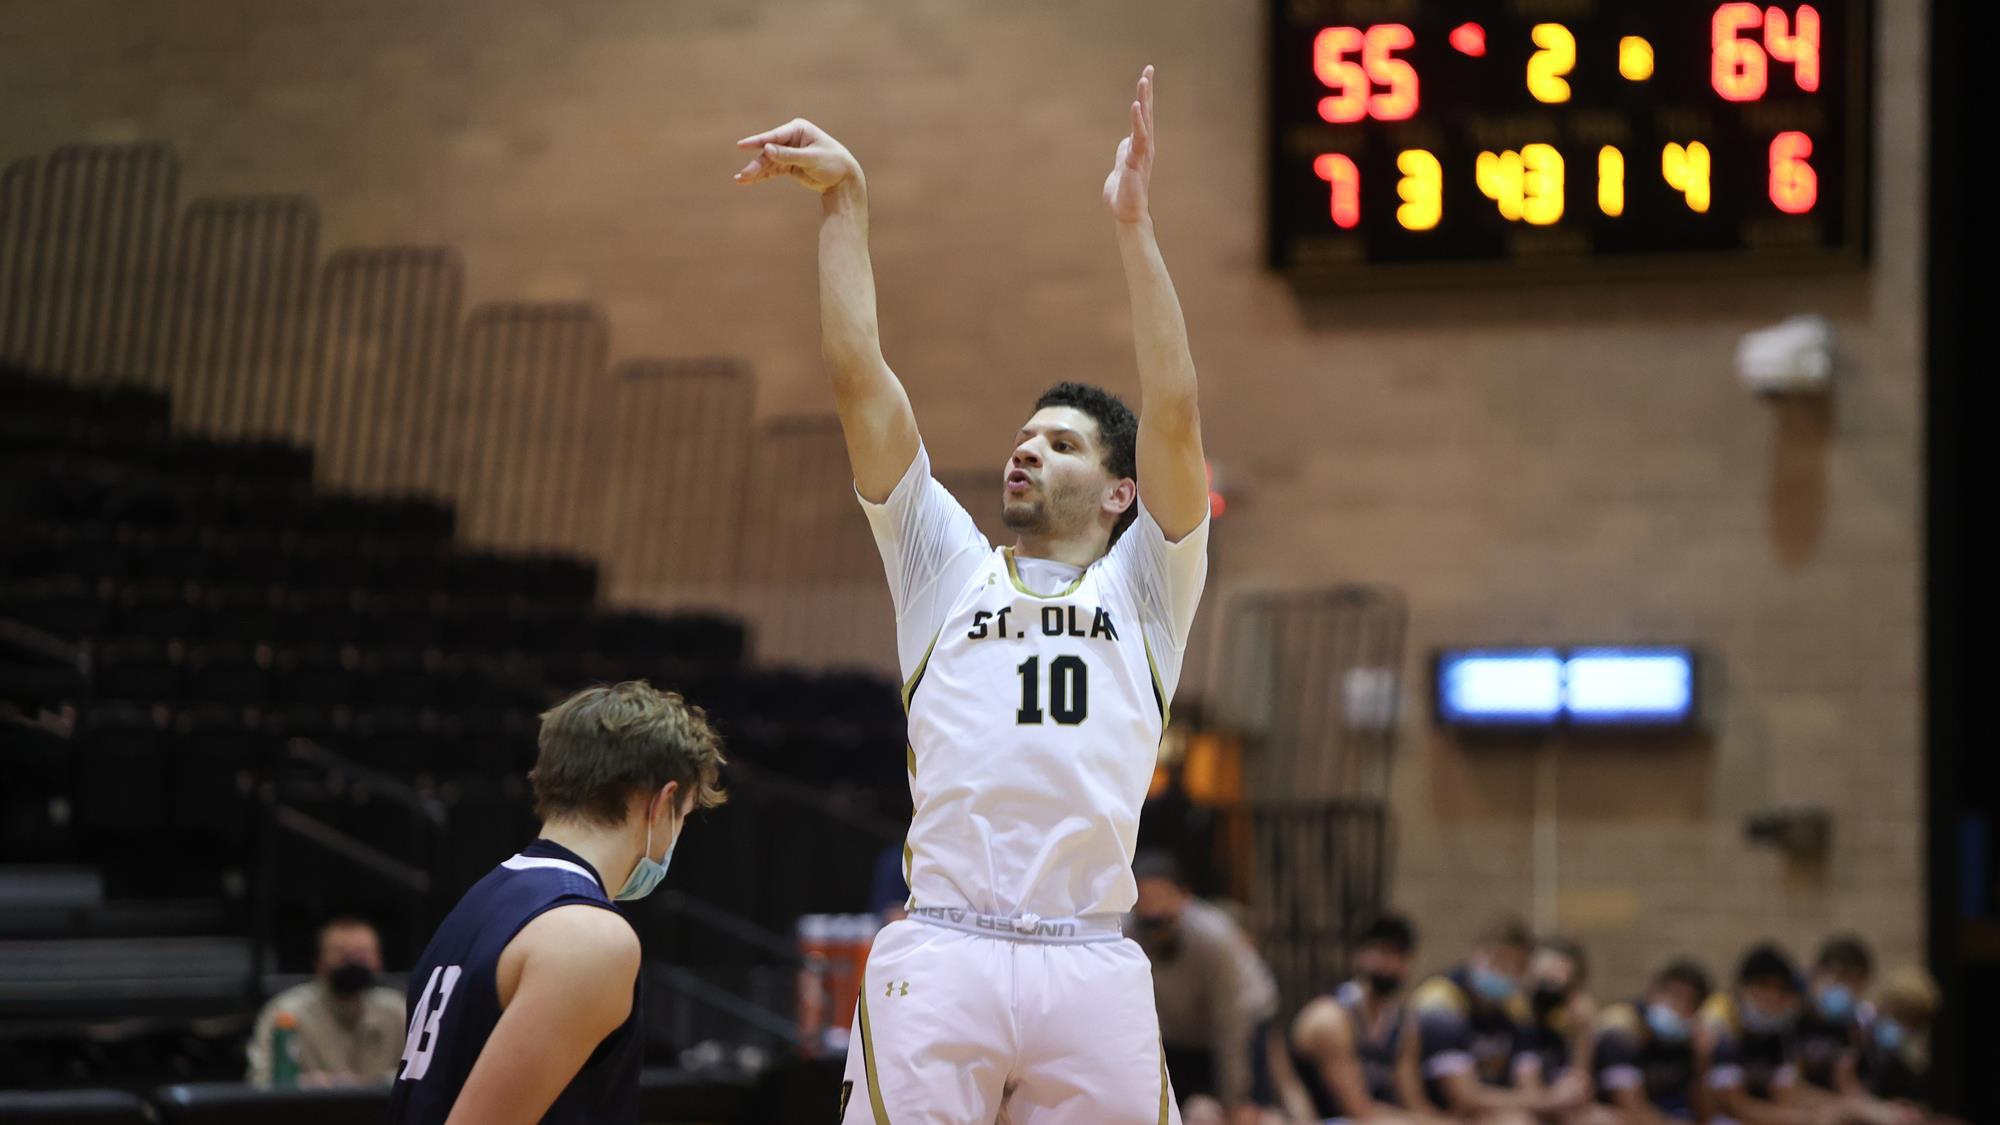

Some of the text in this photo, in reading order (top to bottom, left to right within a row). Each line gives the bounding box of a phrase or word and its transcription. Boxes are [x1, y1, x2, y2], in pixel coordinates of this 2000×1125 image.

[1314, 24, 1419, 123] 55
[1527, 23, 1576, 103] 2
[1712, 2, 1820, 102] 64
[1314, 153, 1360, 229] 7
[1396, 149, 1442, 230] 3
[1476, 143, 1565, 225] 43
[1598, 145, 1624, 217] 1
[1662, 140, 1711, 213] 4
[1769, 131, 1817, 214] 6
[967, 606, 1024, 640] ST.
[1016, 654, 1088, 726] 10
[400, 965, 462, 1080] 43
